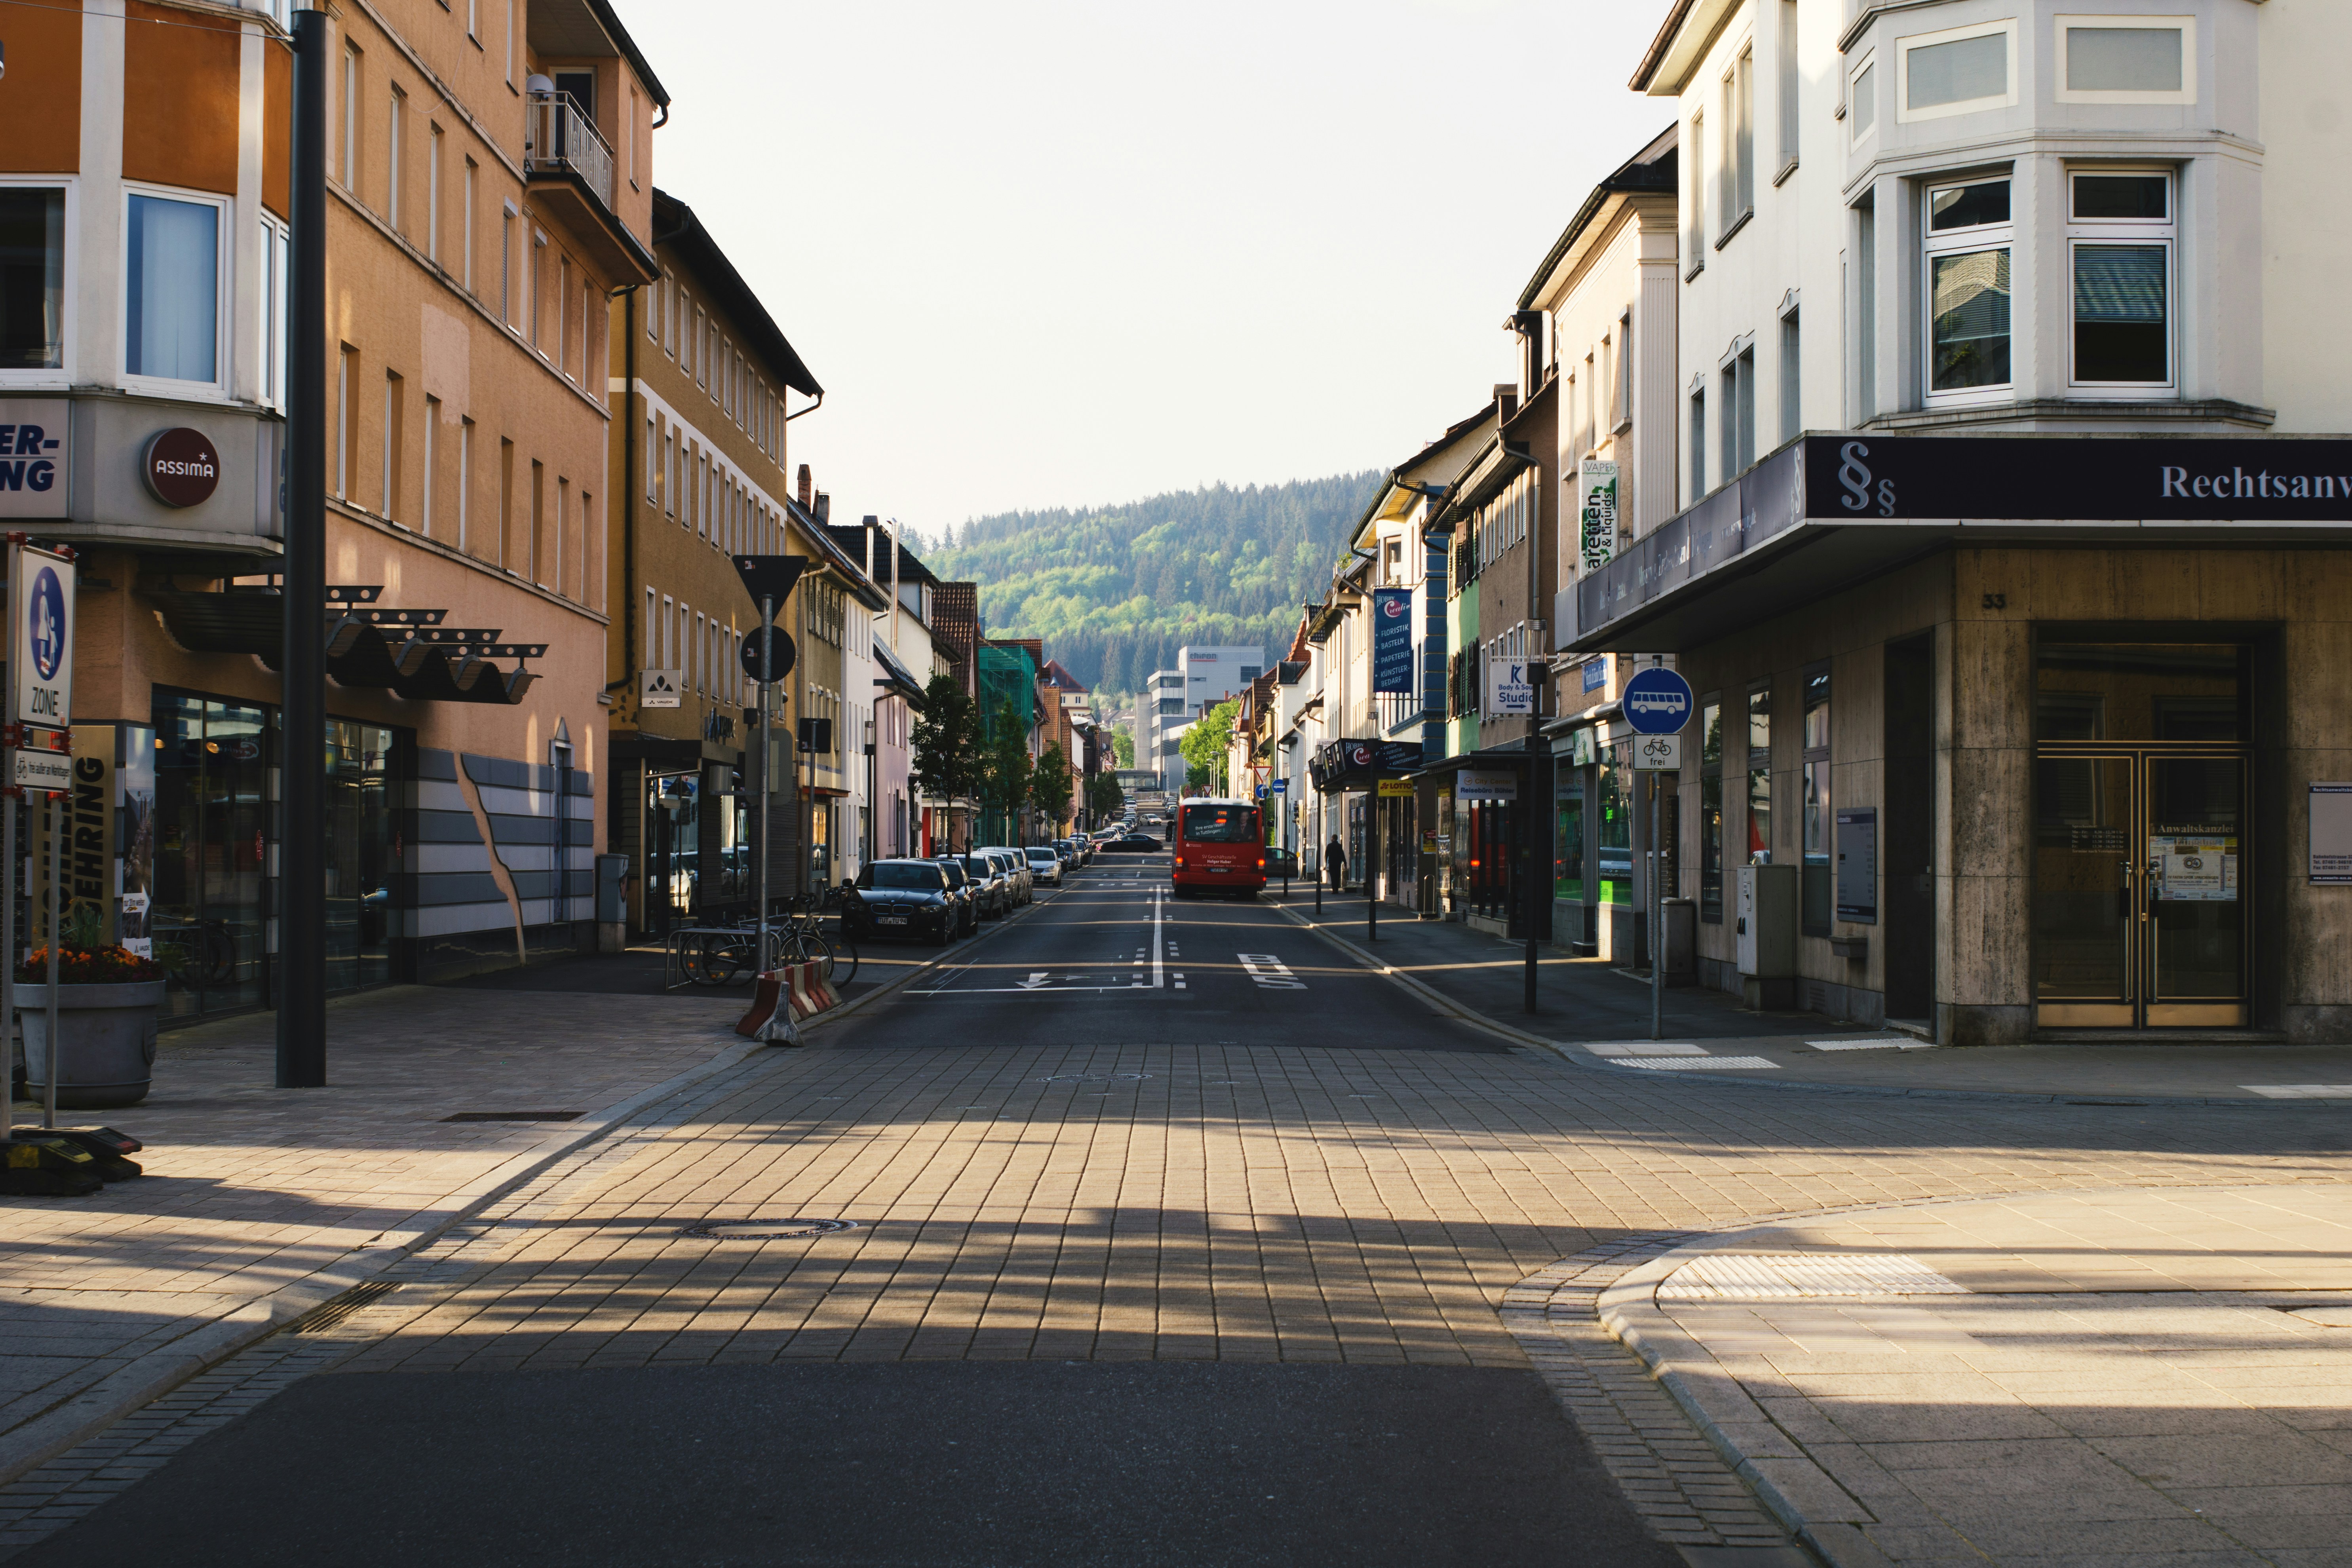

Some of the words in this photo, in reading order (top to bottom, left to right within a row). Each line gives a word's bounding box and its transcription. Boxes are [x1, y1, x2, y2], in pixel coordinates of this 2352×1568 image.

[156, 460, 214, 477] ASSIMA
[1601, 493, 1614, 535] Liquids
[1585, 494, 1601, 571] aretten
[1376, 595, 1395, 608] HOBBY
[1983, 594, 2006, 609] 33
[1384, 601, 1410, 618] Creativ
[1381, 623, 1409, 637] FLORISTIK
[1381, 637, 1404, 650] BASTELN
[1381, 650, 1410, 664] PAPETERIE
[1381, 665, 1410, 678] KÜNSTLER-
[1381, 676, 1402, 687] BEDARF
[32, 686, 59, 717] ZONE
[1346, 742, 1364, 755] HOBBY
[2158, 824, 2234, 833] Anwaltskanzlei
[1236, 953, 1308, 989] BUS
